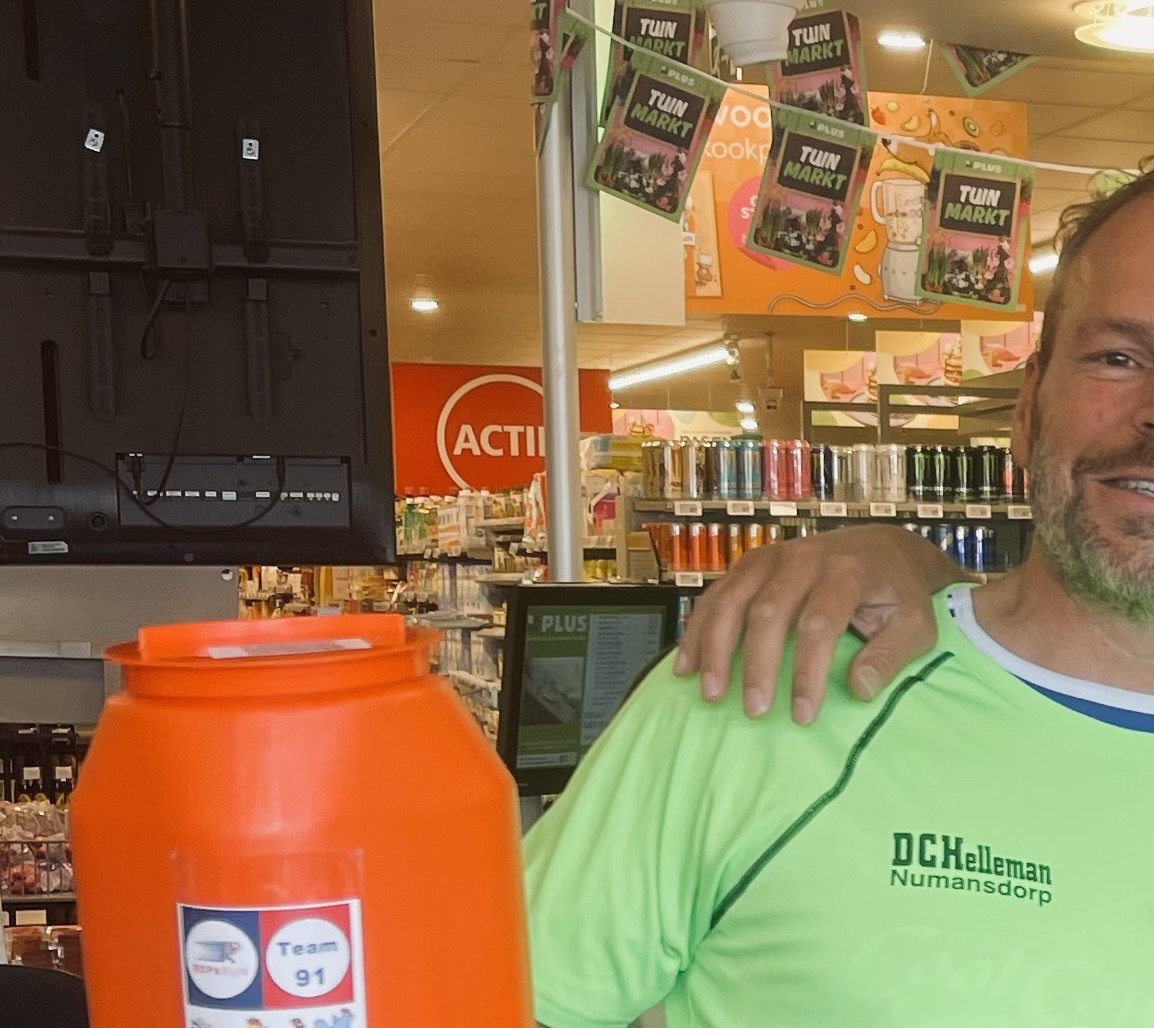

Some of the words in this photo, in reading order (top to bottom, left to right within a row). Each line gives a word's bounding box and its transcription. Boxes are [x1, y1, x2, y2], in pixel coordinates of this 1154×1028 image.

[640, 18, 678, 39] TUIN
[792, 23, 831, 46] TUIN
[784, 39, 845, 67] MARKT
[667, 69, 695, 86] PLUS
[648, 88, 689, 118] TUIN
[630, 103, 693, 138] MARKT
[816, 124, 845, 138] PLUS
[800, 146, 841, 171] TUIN
[972, 161, 1002, 173] PLUS
[783, 160, 848, 191] MARKT
[960, 185, 1001, 207] TUIN
[944, 203, 1010, 226] MARKT
[541, 614, 588, 633] PLUS
[890, 869, 1052, 907] Numansdorp
[277, 940, 339, 958] Team
[295, 967, 325, 987] 91
